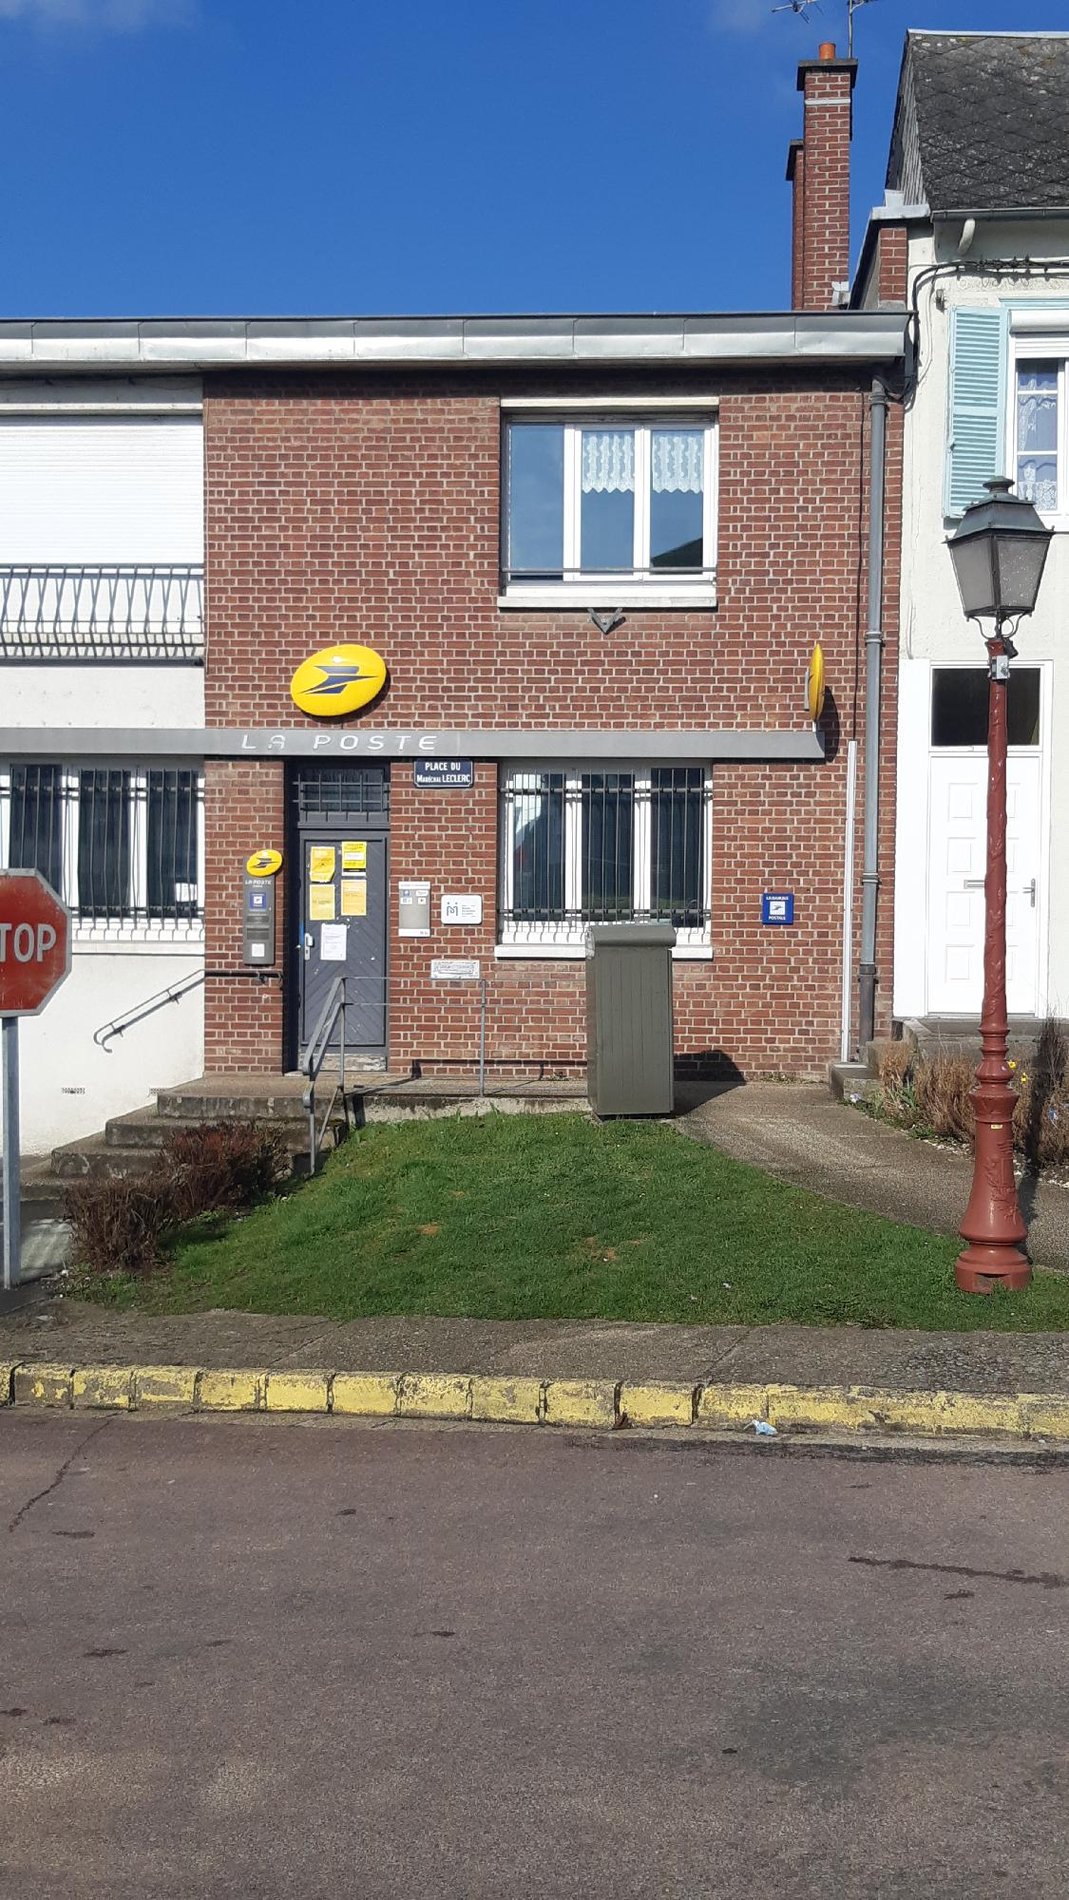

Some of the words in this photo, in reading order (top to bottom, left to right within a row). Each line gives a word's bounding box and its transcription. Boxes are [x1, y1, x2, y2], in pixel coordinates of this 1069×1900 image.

[242, 734, 286, 750] LA
[313, 734, 438, 750] POSTE
[425, 762, 448, 771] PLACE
[450, 762, 461, 771] DU
[442, 774, 471, 783] LECLERC
